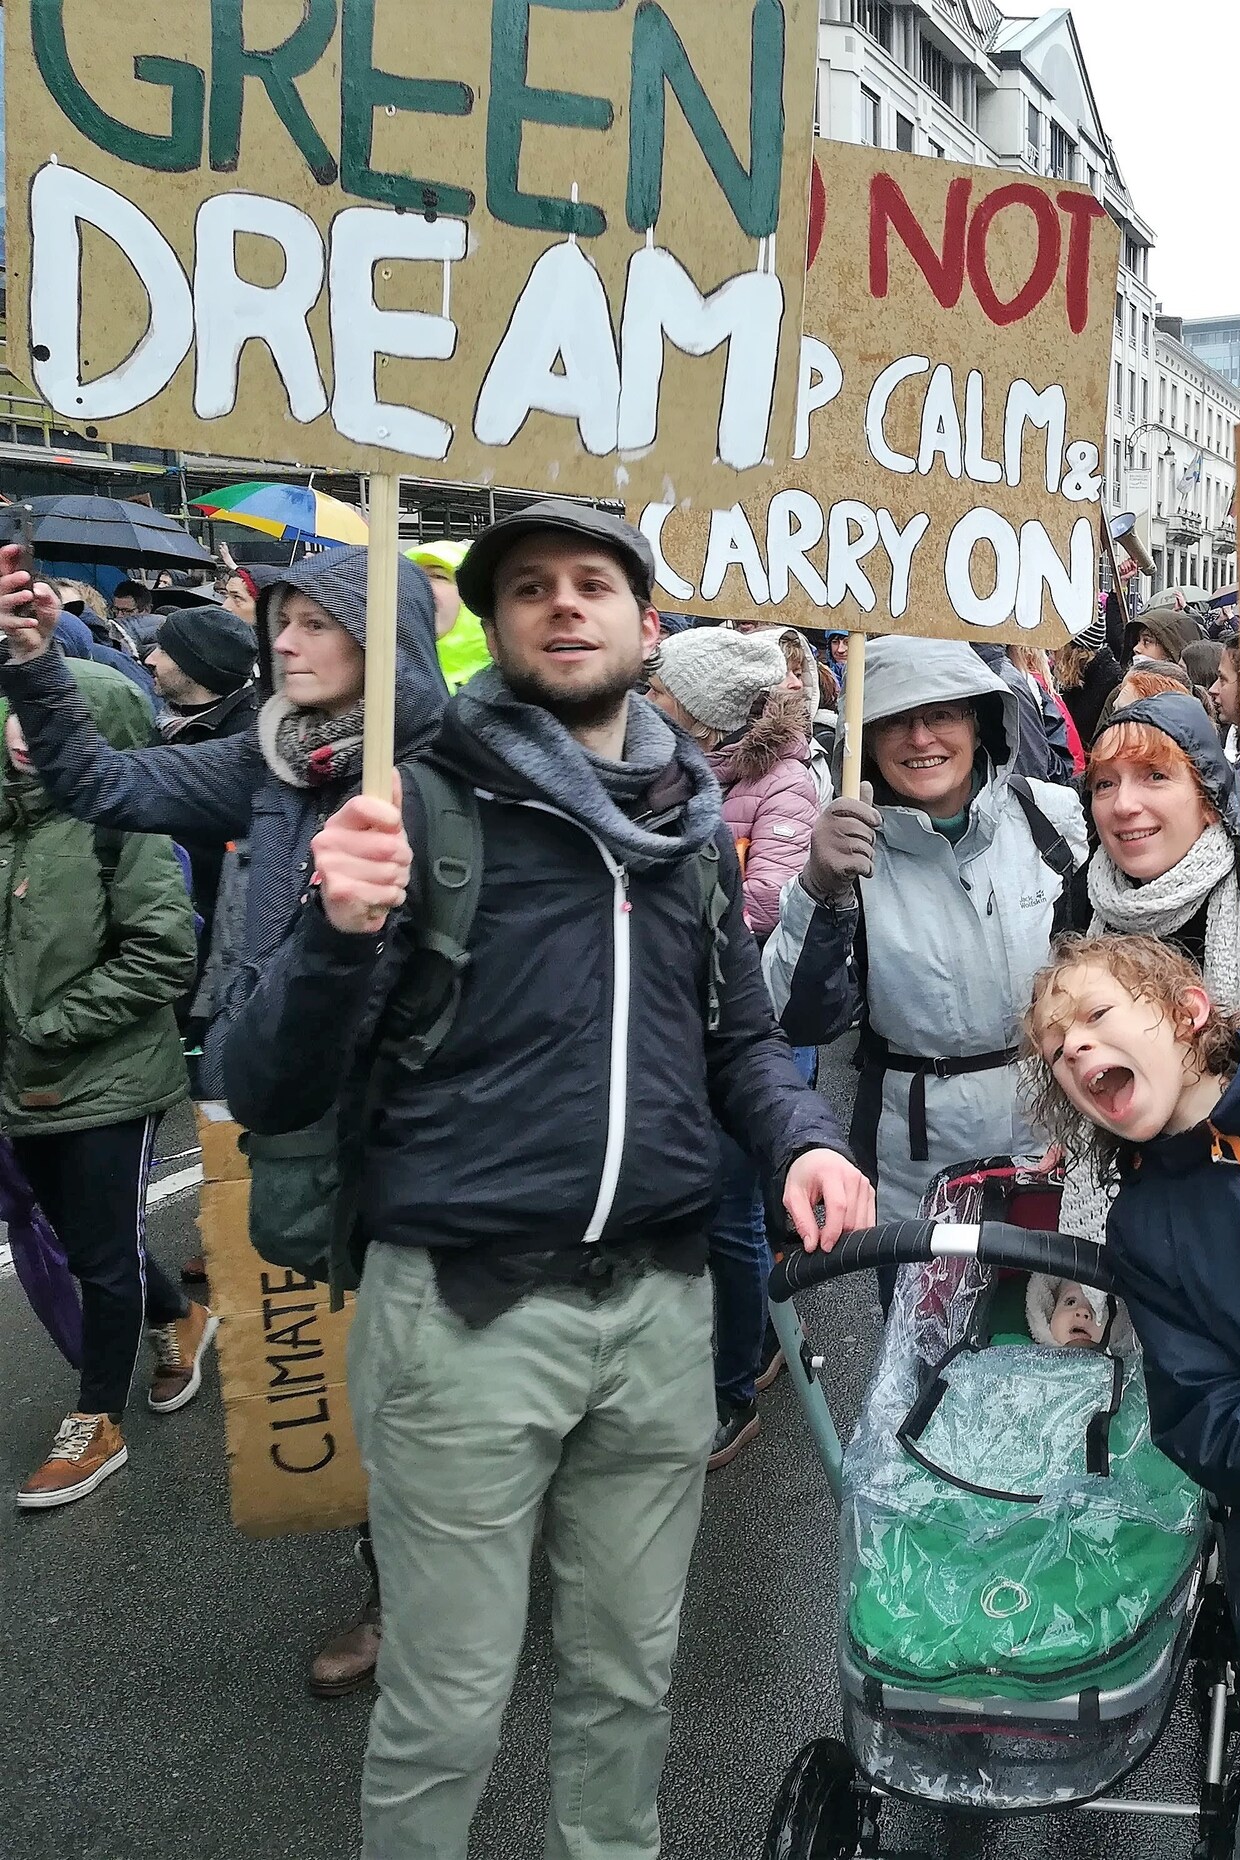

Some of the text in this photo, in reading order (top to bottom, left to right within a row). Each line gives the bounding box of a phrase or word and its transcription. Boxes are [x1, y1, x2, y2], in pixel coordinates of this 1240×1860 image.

[28, 0, 785, 237] GREEN
[29, 157, 785, 471] DREAM
[868, 172, 1107, 334] NOT
[865, 355, 1066, 494] CALM
[639, 488, 1097, 635] CARRY ON
[261, 1267, 337, 1475] CLIMATE
